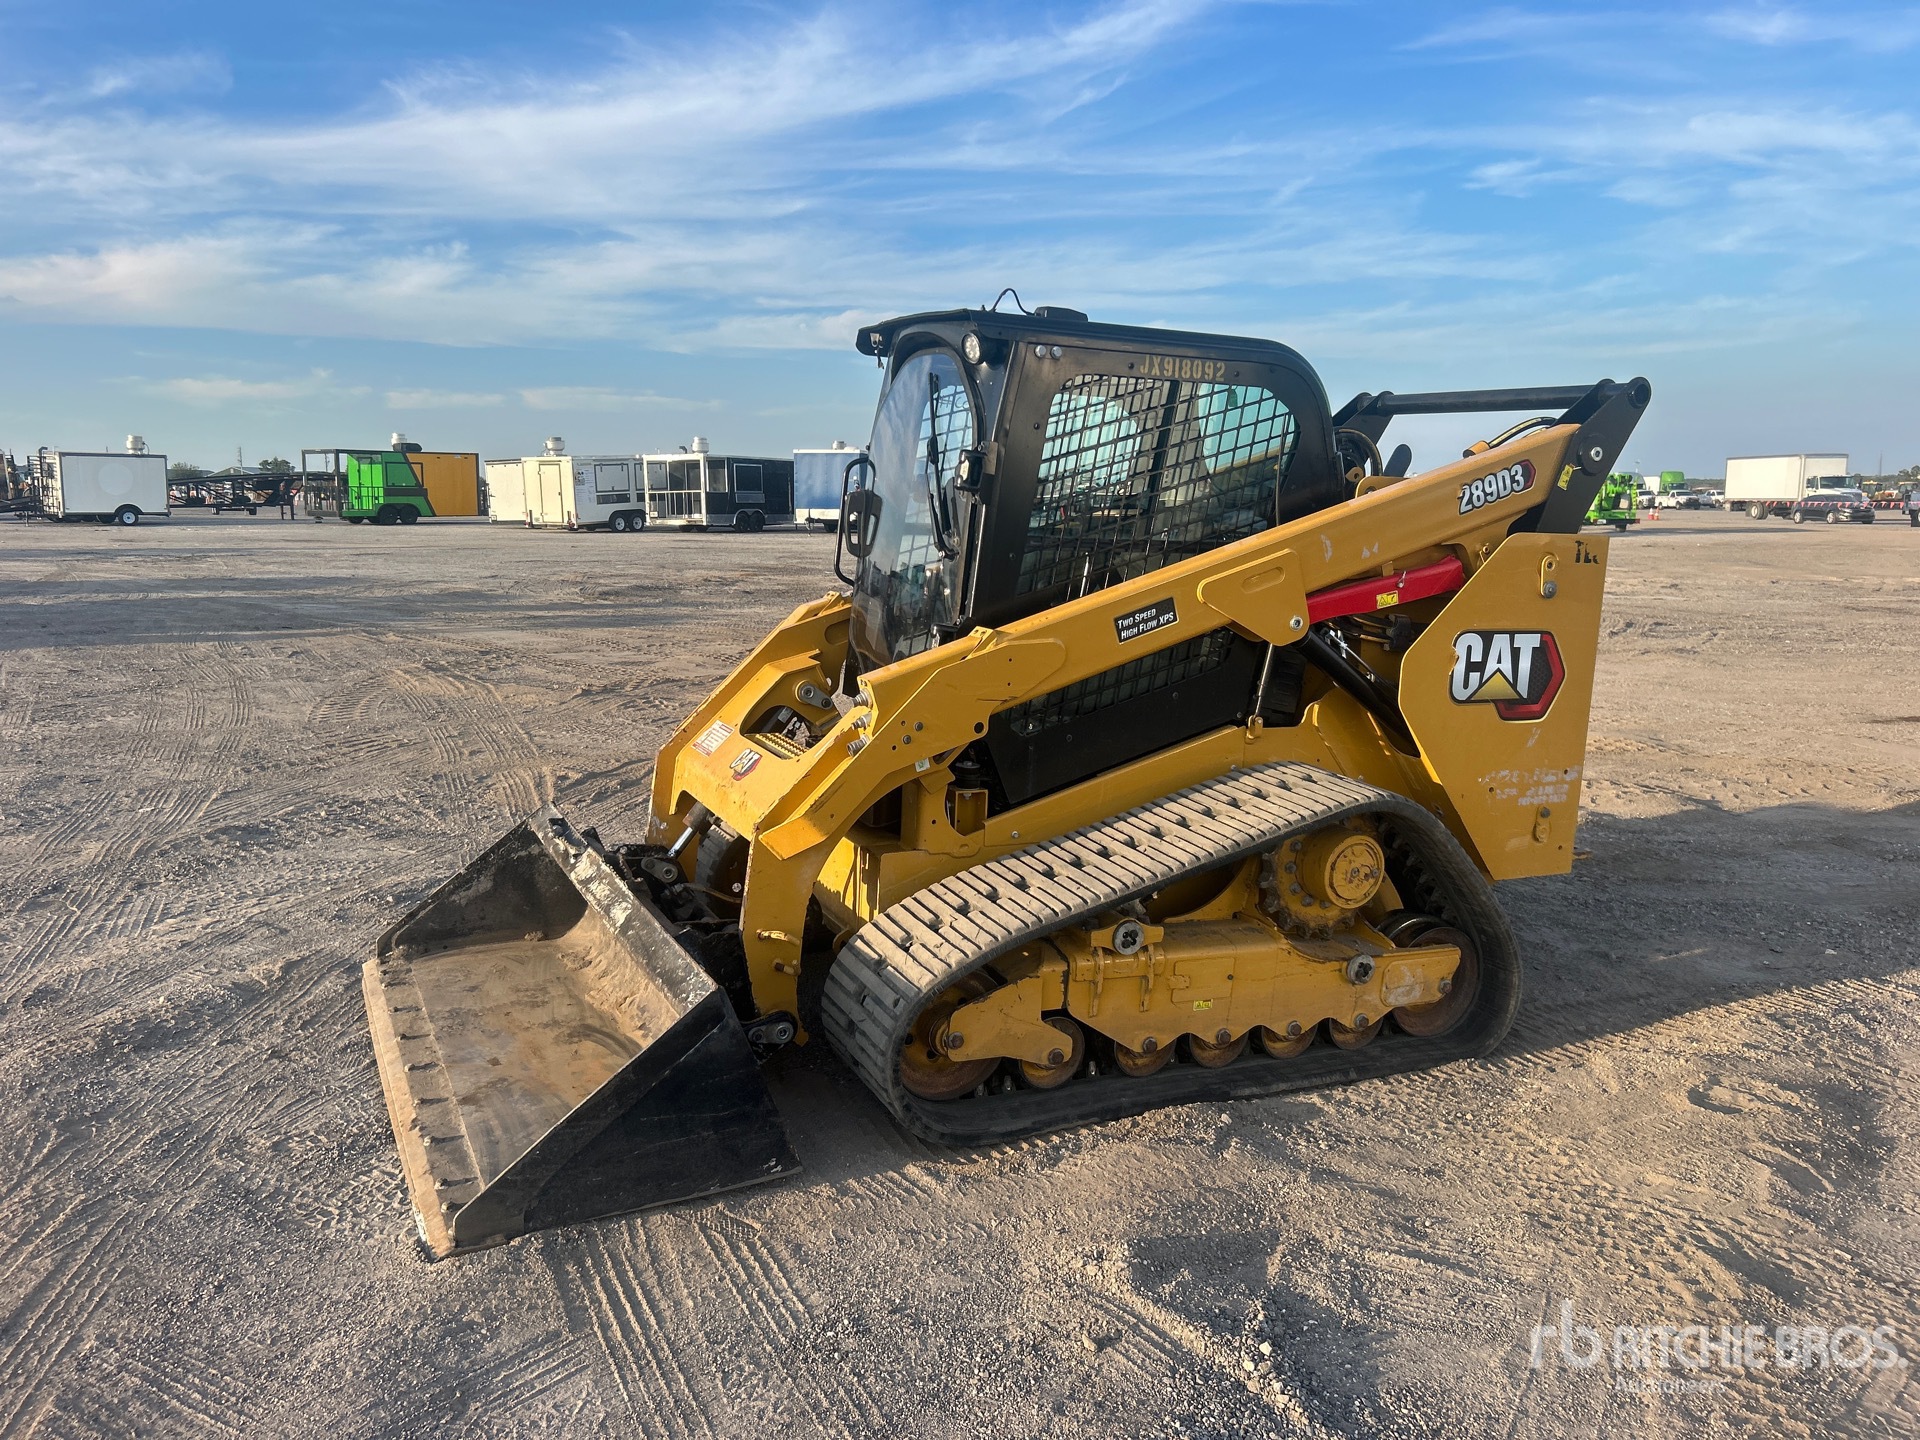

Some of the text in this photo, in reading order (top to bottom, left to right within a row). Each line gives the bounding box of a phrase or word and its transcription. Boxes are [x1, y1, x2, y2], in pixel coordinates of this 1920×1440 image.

[1140, 354, 1225, 382] JX918092
[1460, 464, 1525, 513] 289D3
[1118, 609, 1156, 629] TWO SPEED
[1121, 612, 1174, 639] HIGH FLOW XPS
[1452, 633, 1541, 701] CAT
[730, 748, 761, 774] CAT
